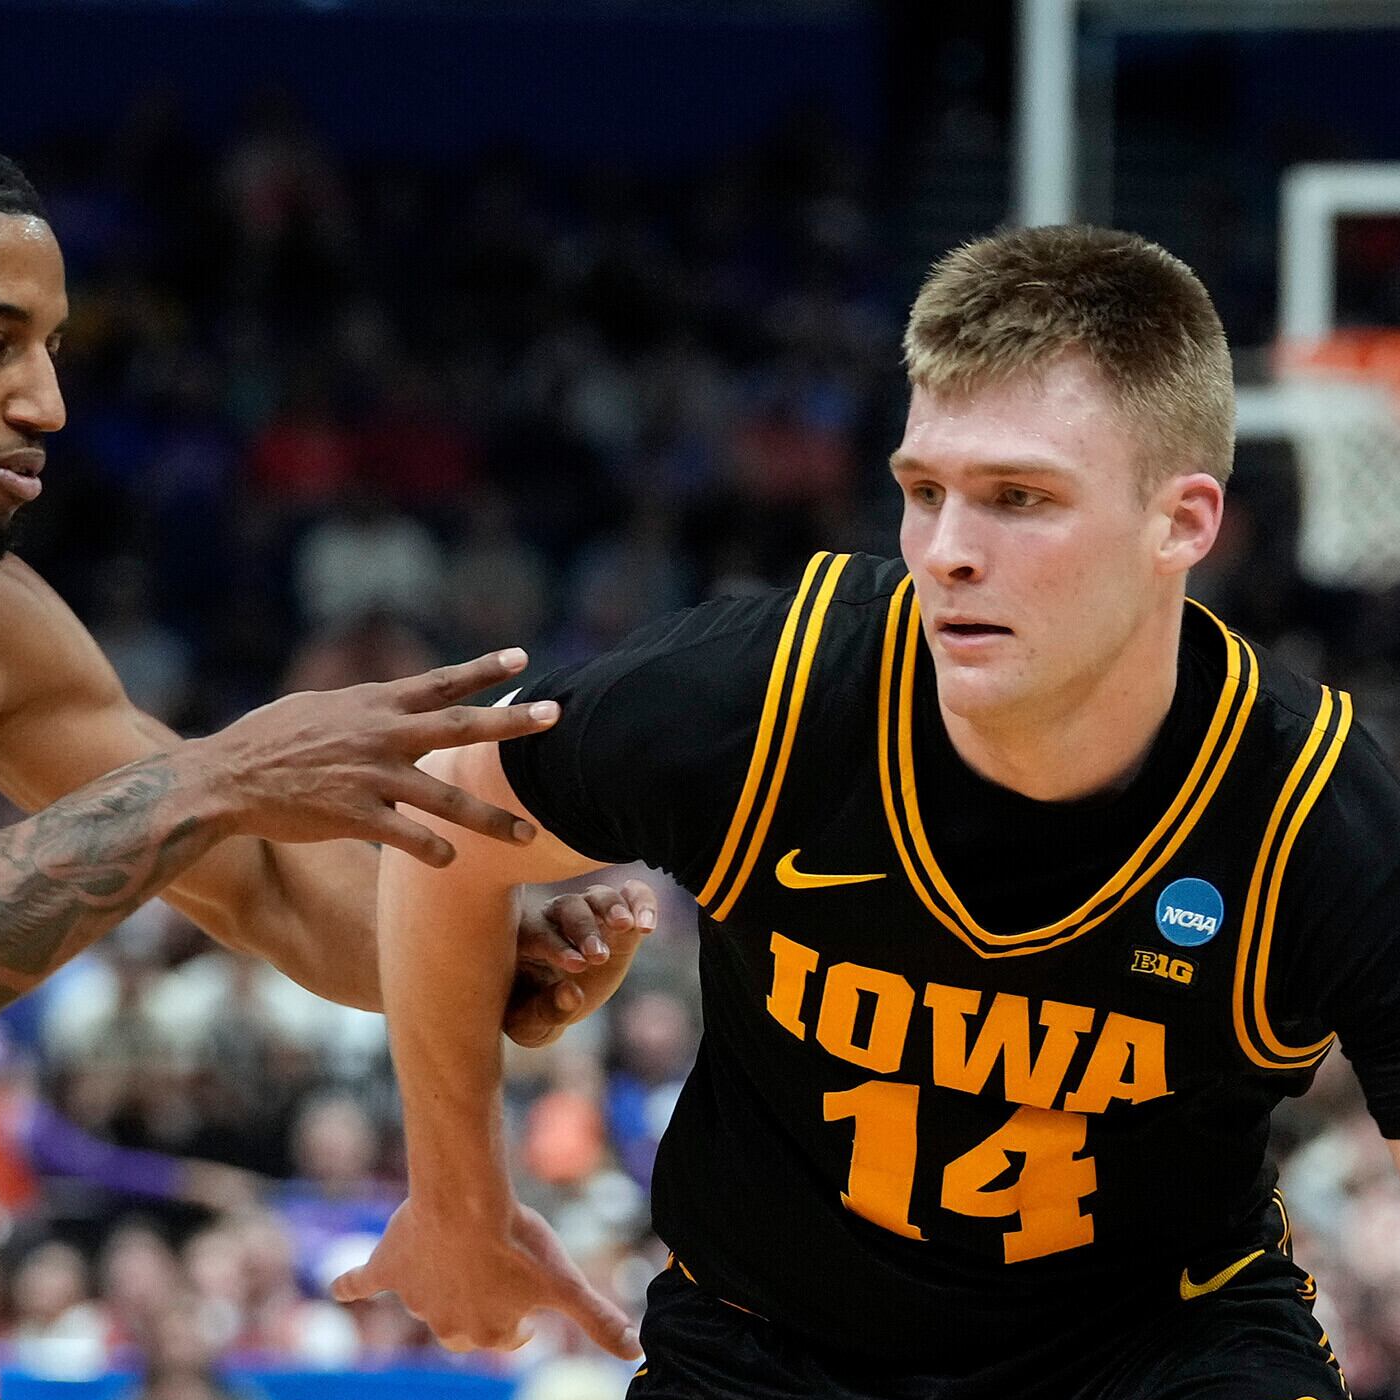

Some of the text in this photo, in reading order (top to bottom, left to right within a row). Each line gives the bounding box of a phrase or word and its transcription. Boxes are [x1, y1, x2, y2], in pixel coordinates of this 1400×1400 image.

[1162, 906, 1217, 935] NCAA
[766, 931, 1175, 1114] IOWA
[823, 1080, 1098, 1264] 14
